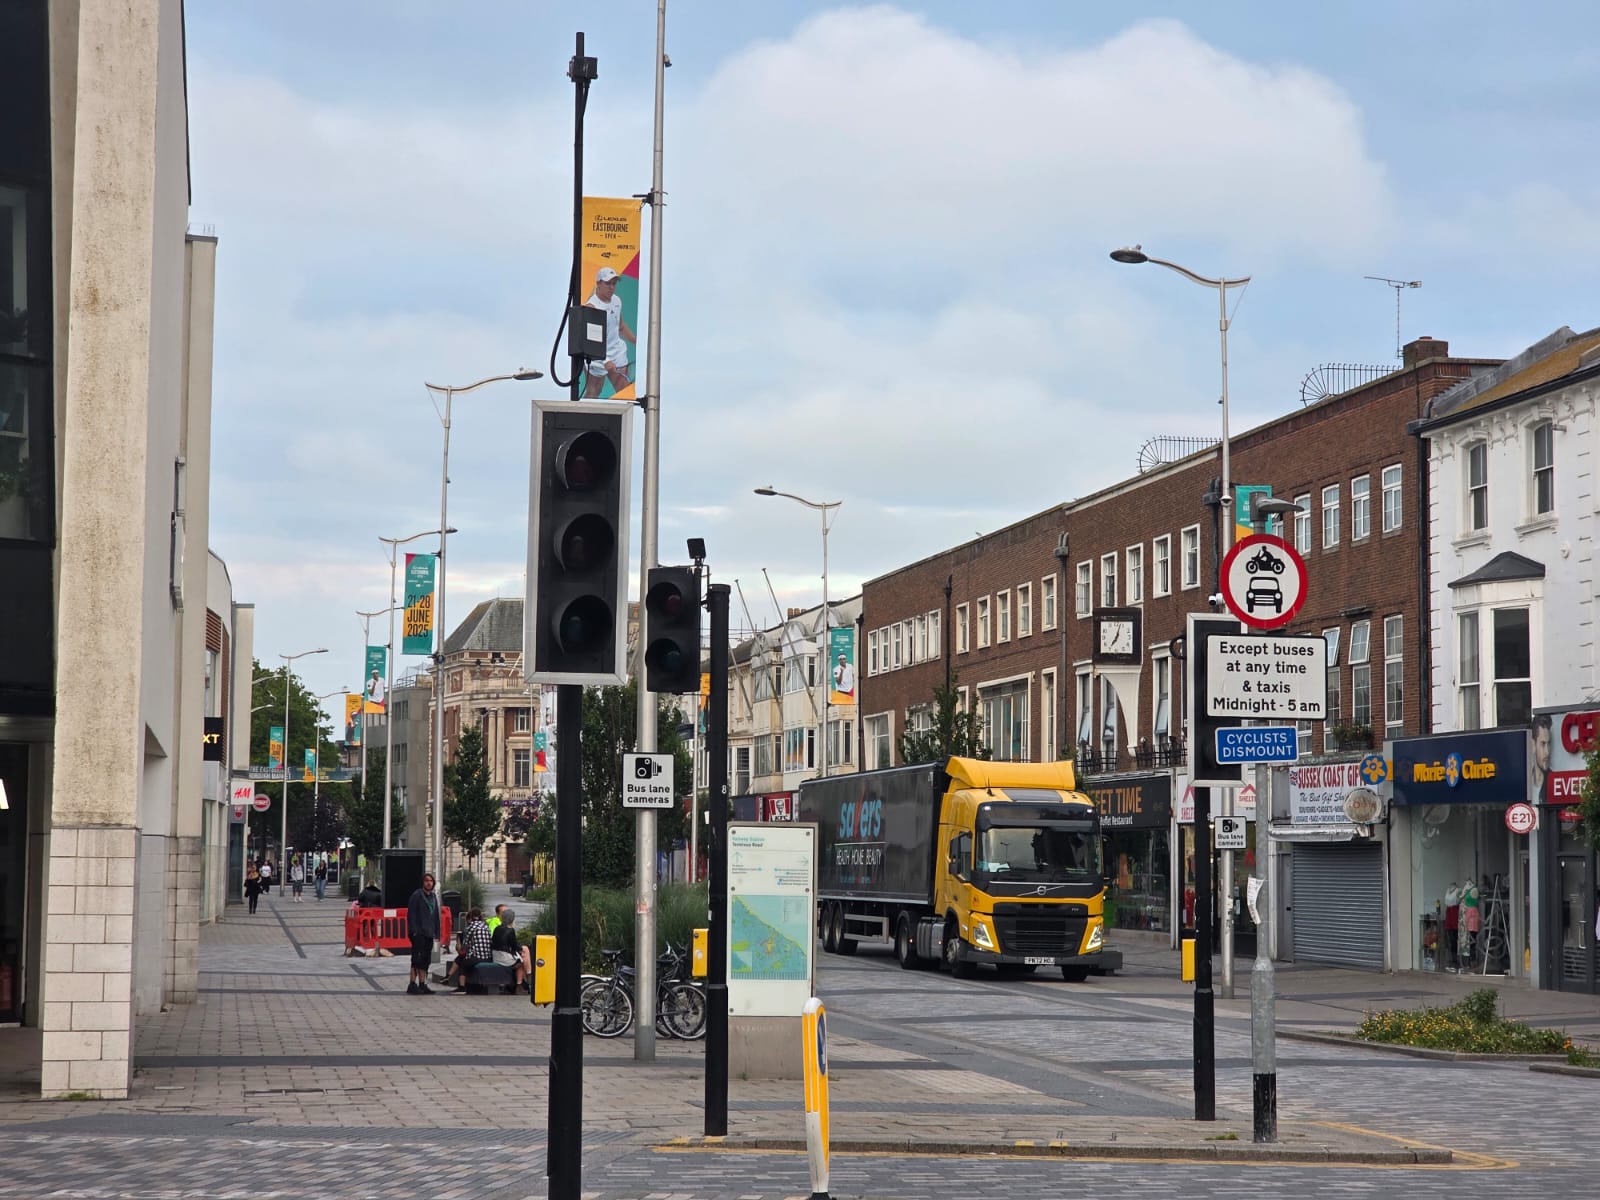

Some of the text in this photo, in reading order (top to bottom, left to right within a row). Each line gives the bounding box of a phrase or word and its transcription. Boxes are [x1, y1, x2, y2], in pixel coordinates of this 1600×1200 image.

[592, 222, 629, 233] EASTBOURNE
[407, 609, 430, 624] JUNE
[407, 623, 430, 638] 2025
[1220, 641, 1315, 657] Except buses
[1226, 660, 1307, 675] at any time
[1242, 680, 1291, 694] & taxis
[1213, 697, 1276, 713] Midnight
[1288, 699, 1297, 712] 5
[1300, 702, 1320, 712] am
[1226, 732, 1288, 745] CYCLISTS
[1222, 746, 1293, 758] DISMOUNT
[1298, 764, 1367, 789] SUSSEX COAST GIF
[1413, 757, 1497, 782] Marie Curie
[627, 783, 671, 793] Bus lane
[627, 796, 670, 804] cameras
[1115, 786, 1143, 814] TIME
[1334, 792, 1346, 802] Sho
[1511, 812, 1531, 824] £21
[851, 848, 864, 865] HOME
[865, 848, 882, 865] BEAUTY
